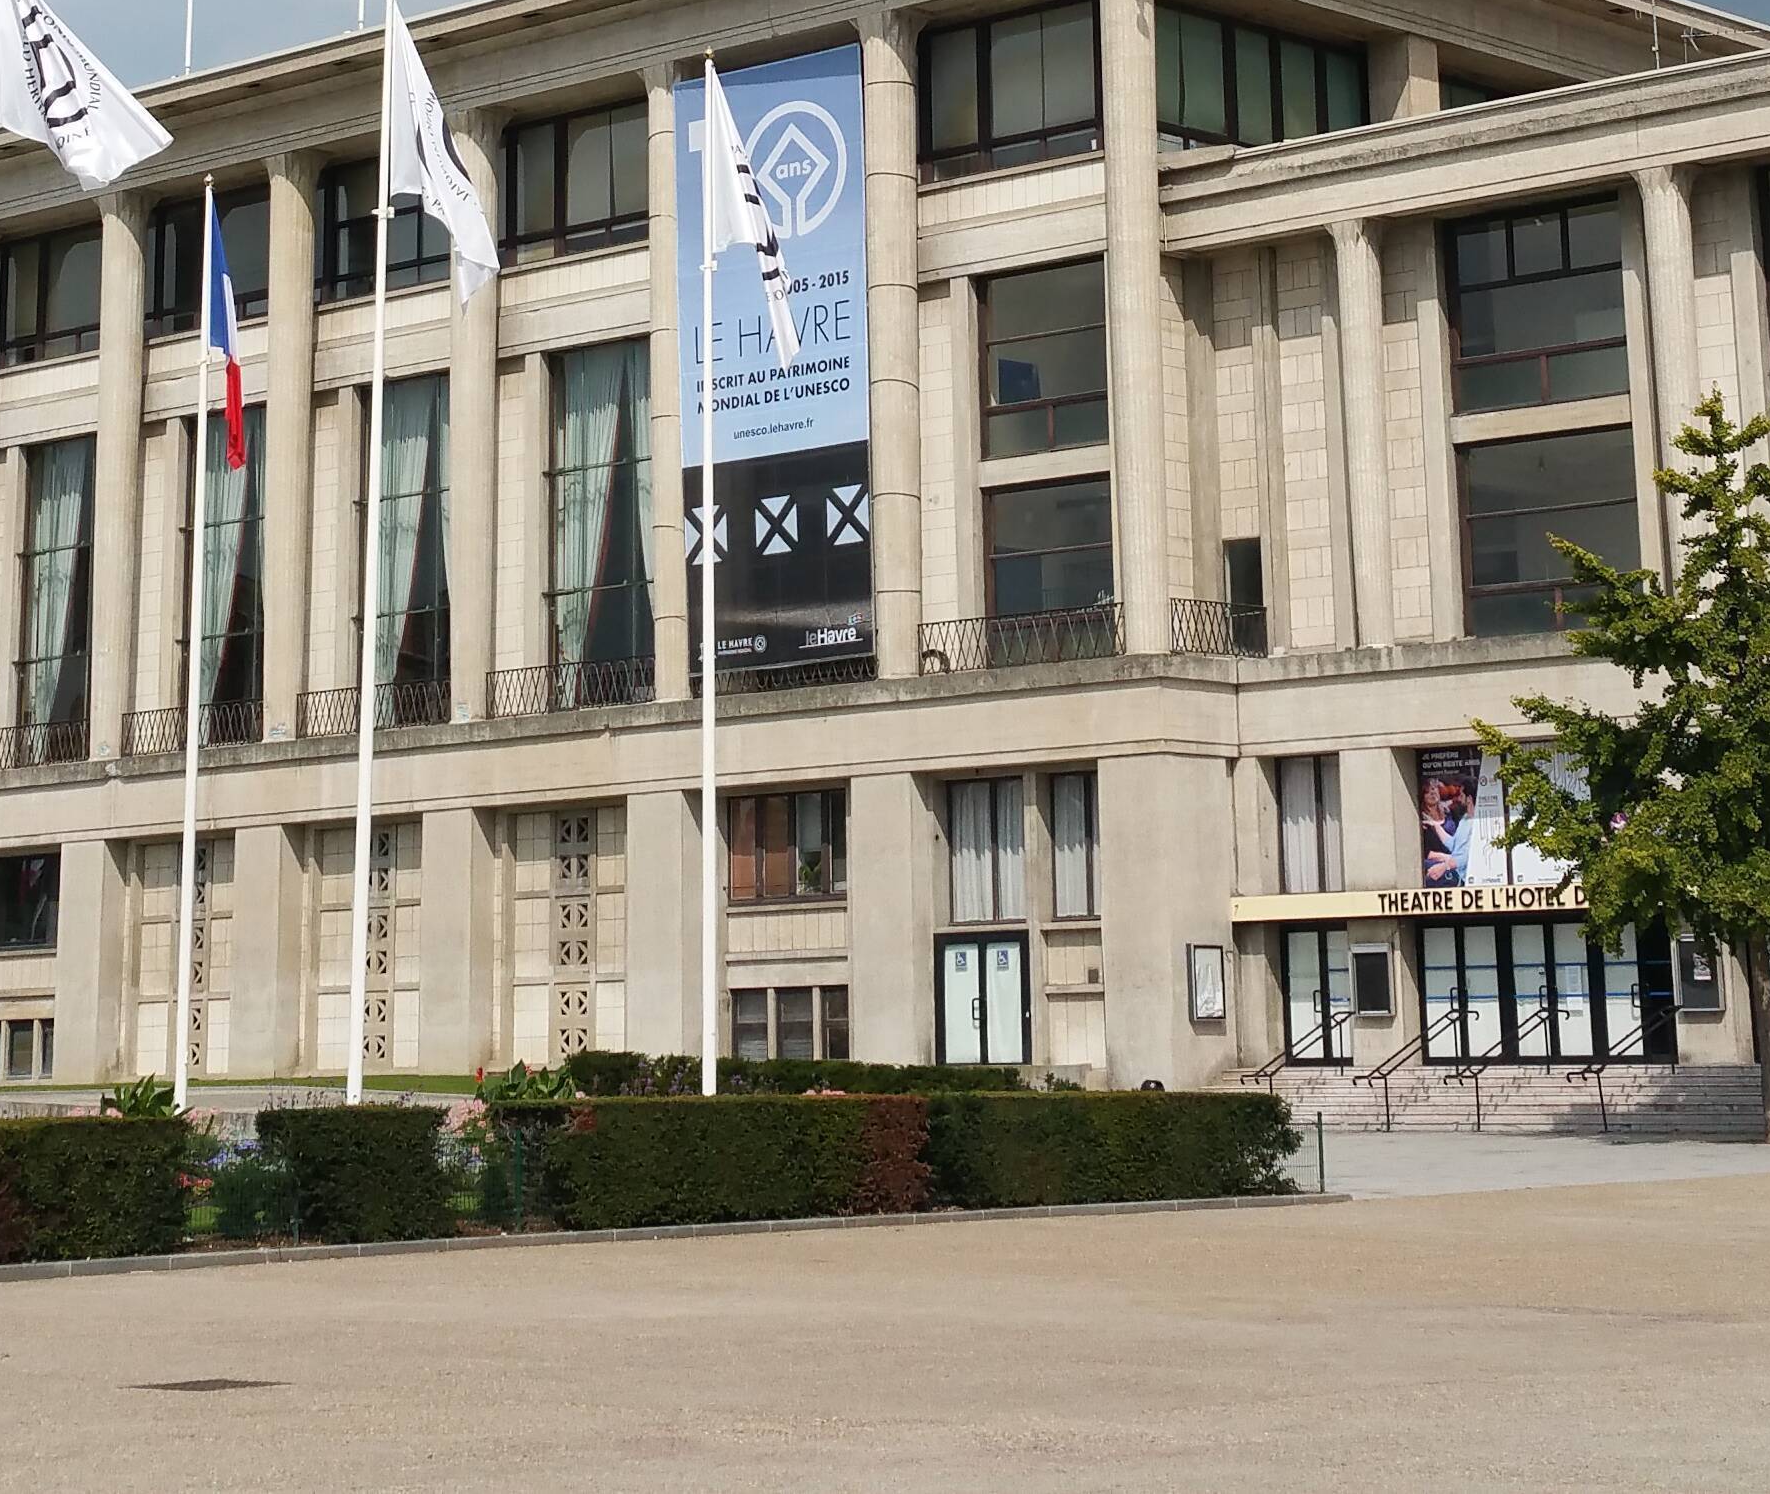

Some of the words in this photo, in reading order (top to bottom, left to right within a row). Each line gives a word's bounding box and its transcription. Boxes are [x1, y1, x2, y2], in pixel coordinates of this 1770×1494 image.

[776, 159, 812, 180] ans
[819, 270, 849, 289] 2015
[695, 322, 723, 364] LE
[747, 370, 766, 385] AU
[770, 356, 849, 381] PATRIMOINE
[764, 388, 780, 404] DE
[784, 377, 850, 400] L'UNESCO
[733, 417, 814, 439] unesco.lehavre.fr
[805, 626, 857, 645] leHavre
[1378, 890, 1454, 914] THEATRE
[1461, 889, 1483, 910] DE
[1491, 885, 1565, 909] L'HOTEL
